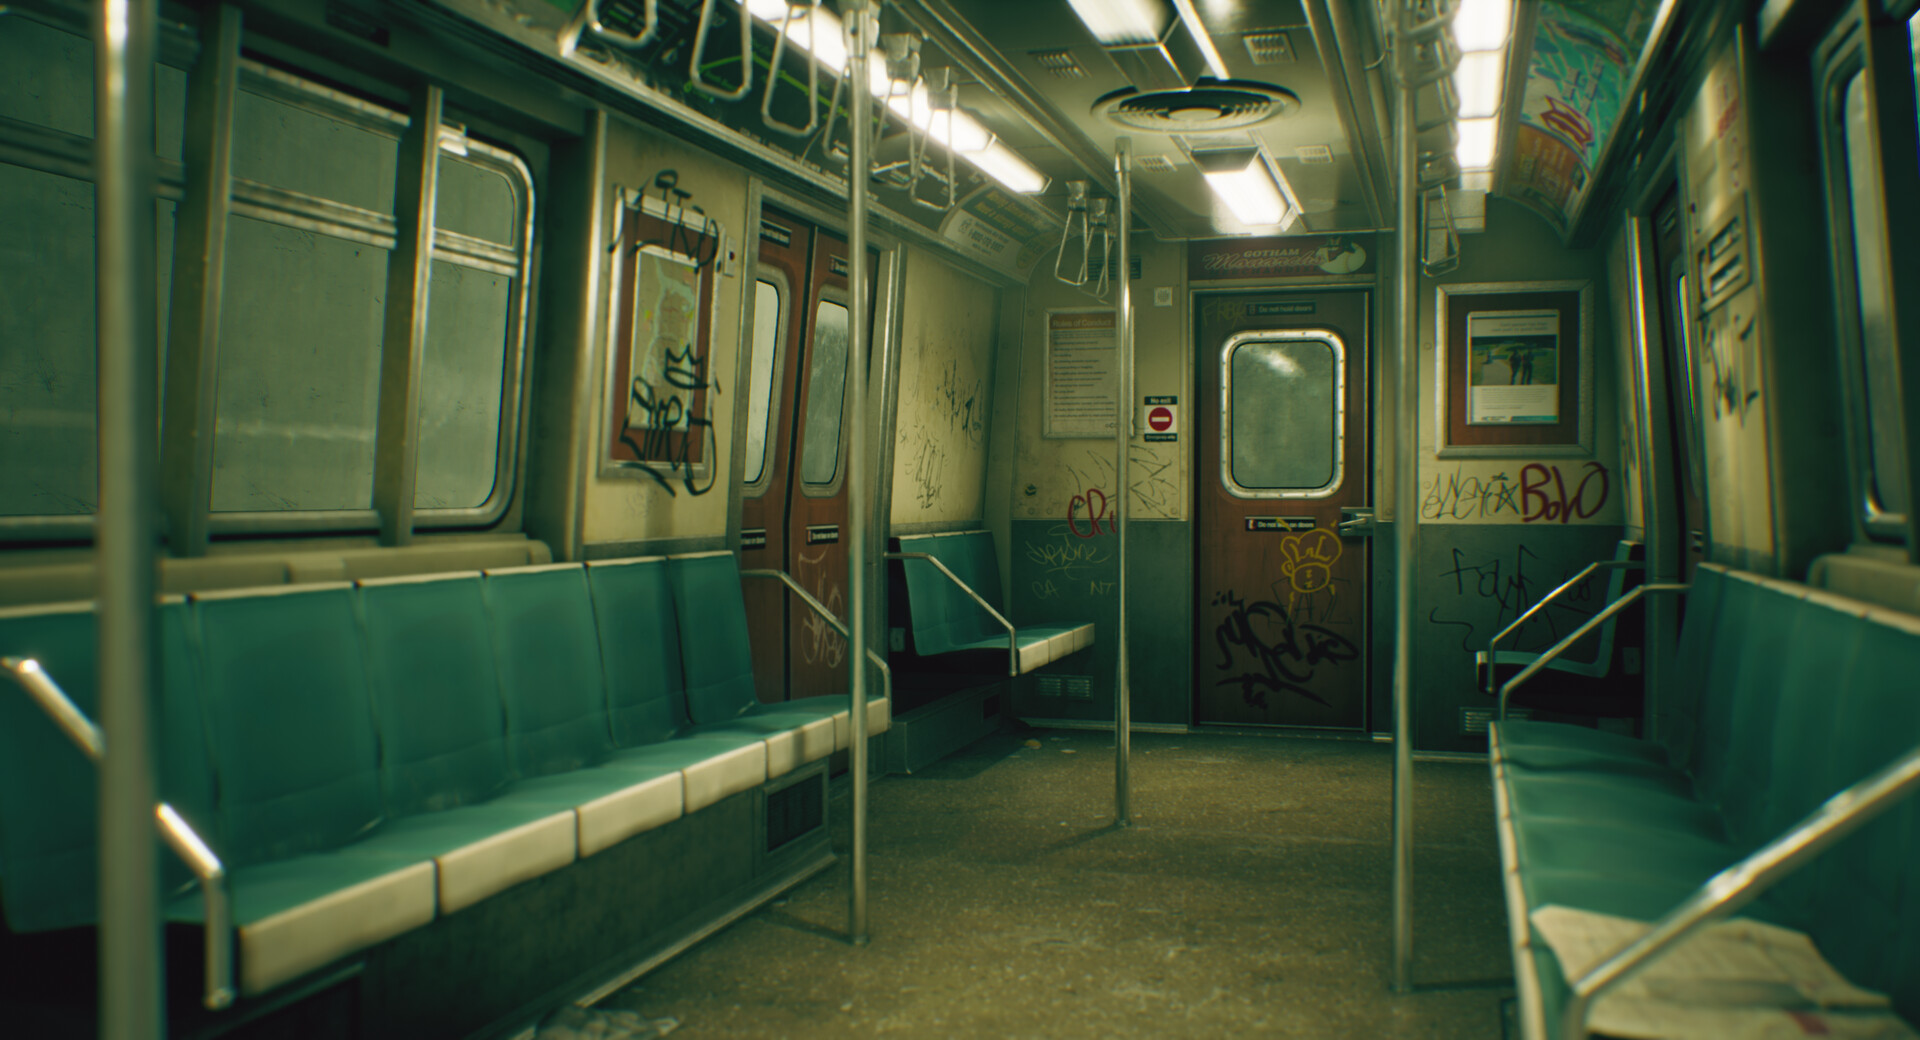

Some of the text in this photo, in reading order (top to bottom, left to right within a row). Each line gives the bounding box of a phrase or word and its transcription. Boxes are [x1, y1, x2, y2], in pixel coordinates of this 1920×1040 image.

[1243, 248, 1300, 258] GOTHAM
[1258, 305, 1268, 313] Do
[1268, 305, 1279, 313] not
[1073, 319, 1081, 327] of
[1081, 318, 1112, 327] Conduct
